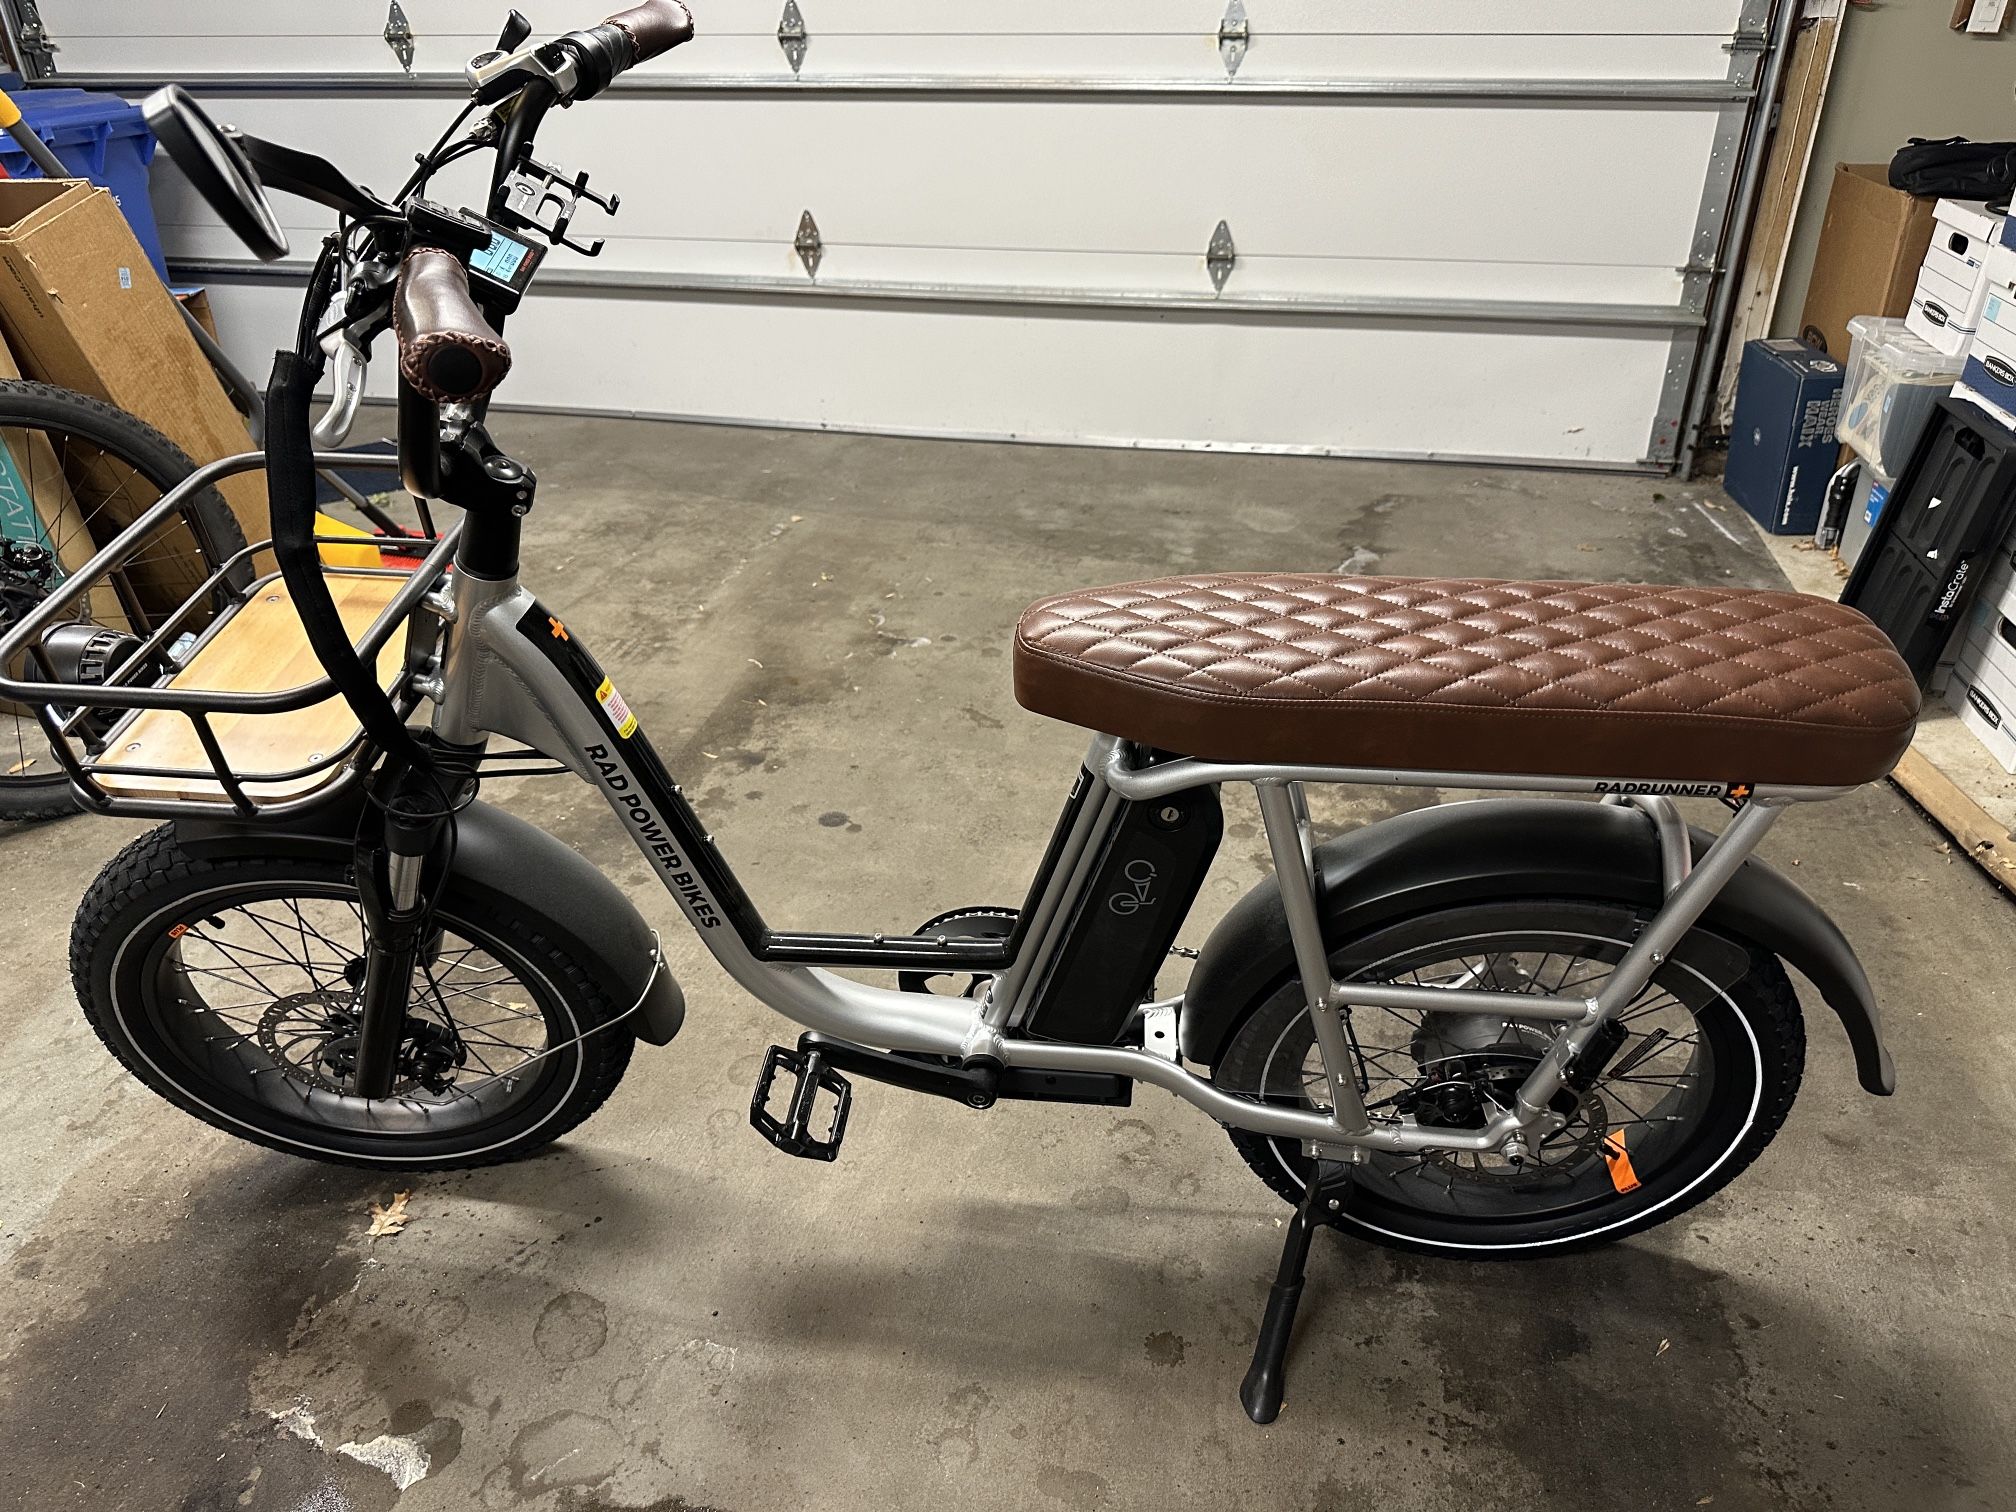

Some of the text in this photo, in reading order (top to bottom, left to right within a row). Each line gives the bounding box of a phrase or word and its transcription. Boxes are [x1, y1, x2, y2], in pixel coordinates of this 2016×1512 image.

[1814, 400, 1830, 435] WEAR
[1822, 388, 1843, 444] HEROES
[1934, 562, 1969, 614] InstaCrate
[1594, 782, 1722, 796] RADRUNNER
[584, 744, 629, 791] RAD
[619, 793, 683, 870] POWER
[671, 872, 721, 929] BIKES
